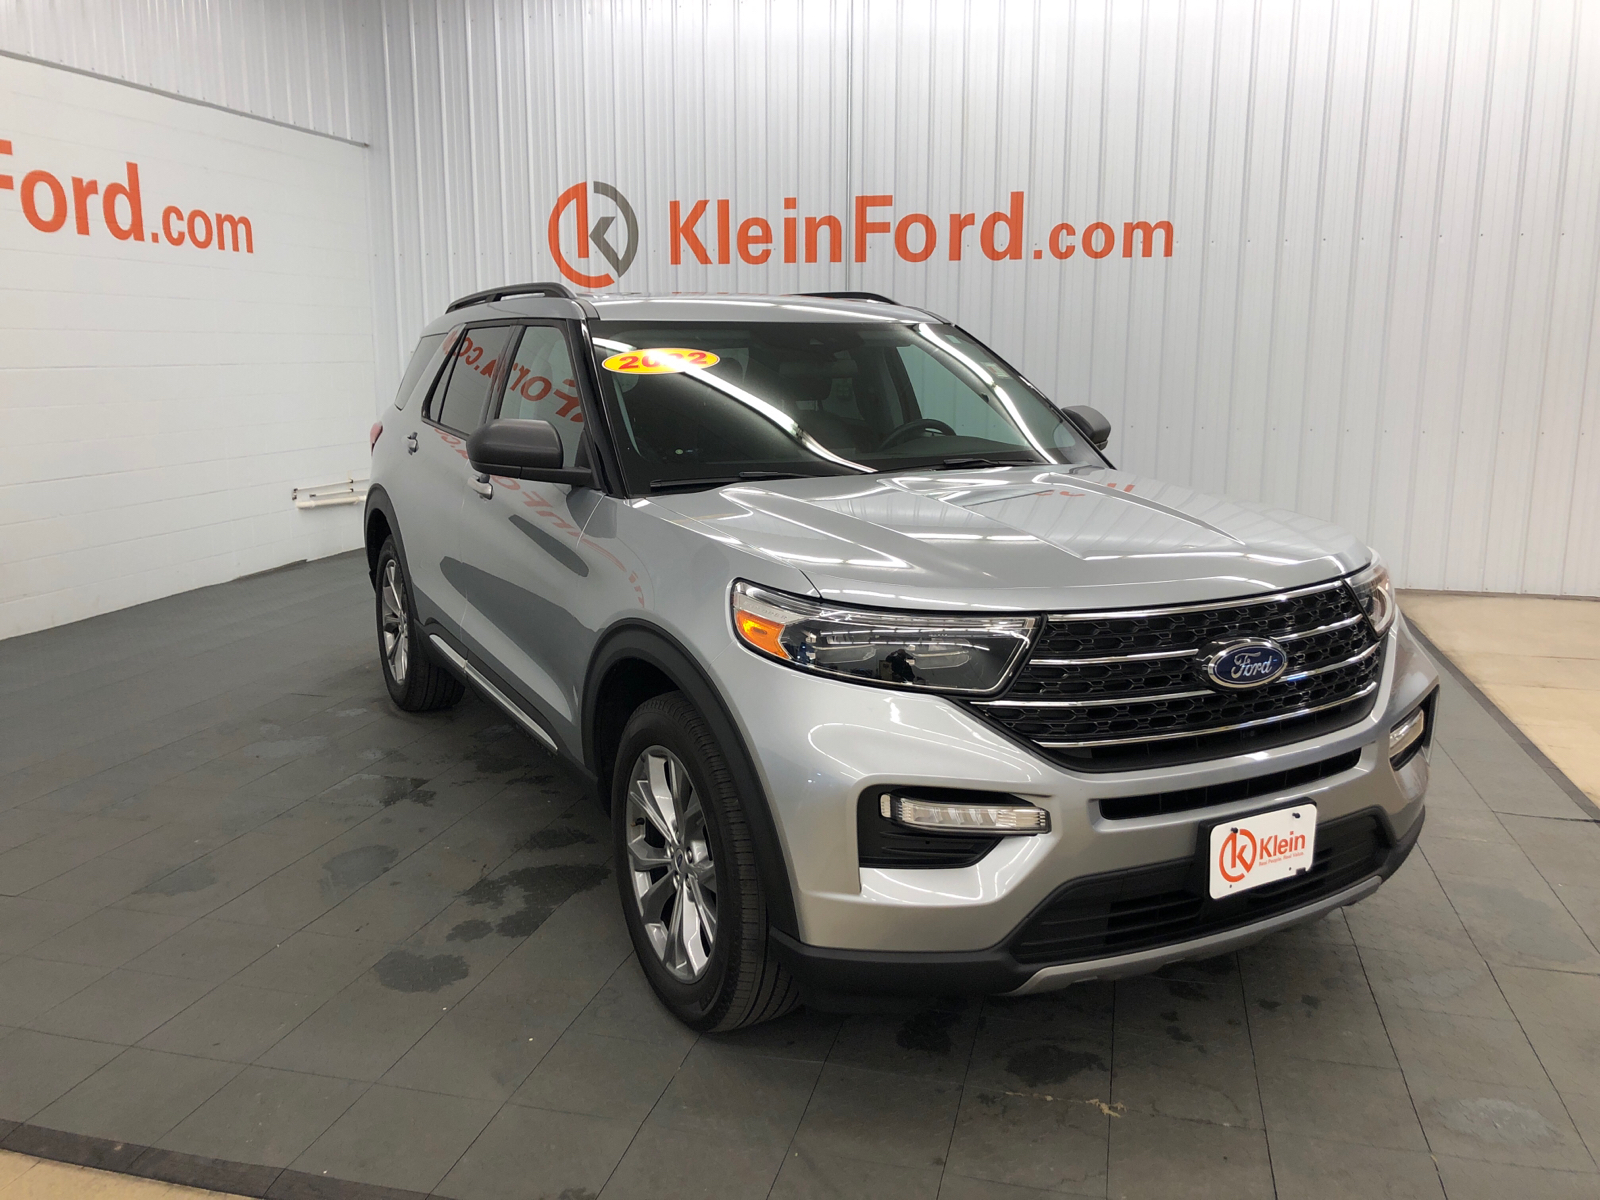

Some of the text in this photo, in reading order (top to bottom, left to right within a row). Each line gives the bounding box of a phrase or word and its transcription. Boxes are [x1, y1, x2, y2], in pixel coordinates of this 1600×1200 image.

[669, 191, 1174, 265] KleinFord.com
[1231, 652, 1273, 678] Ford
[1259, 831, 1306, 860] Klein
